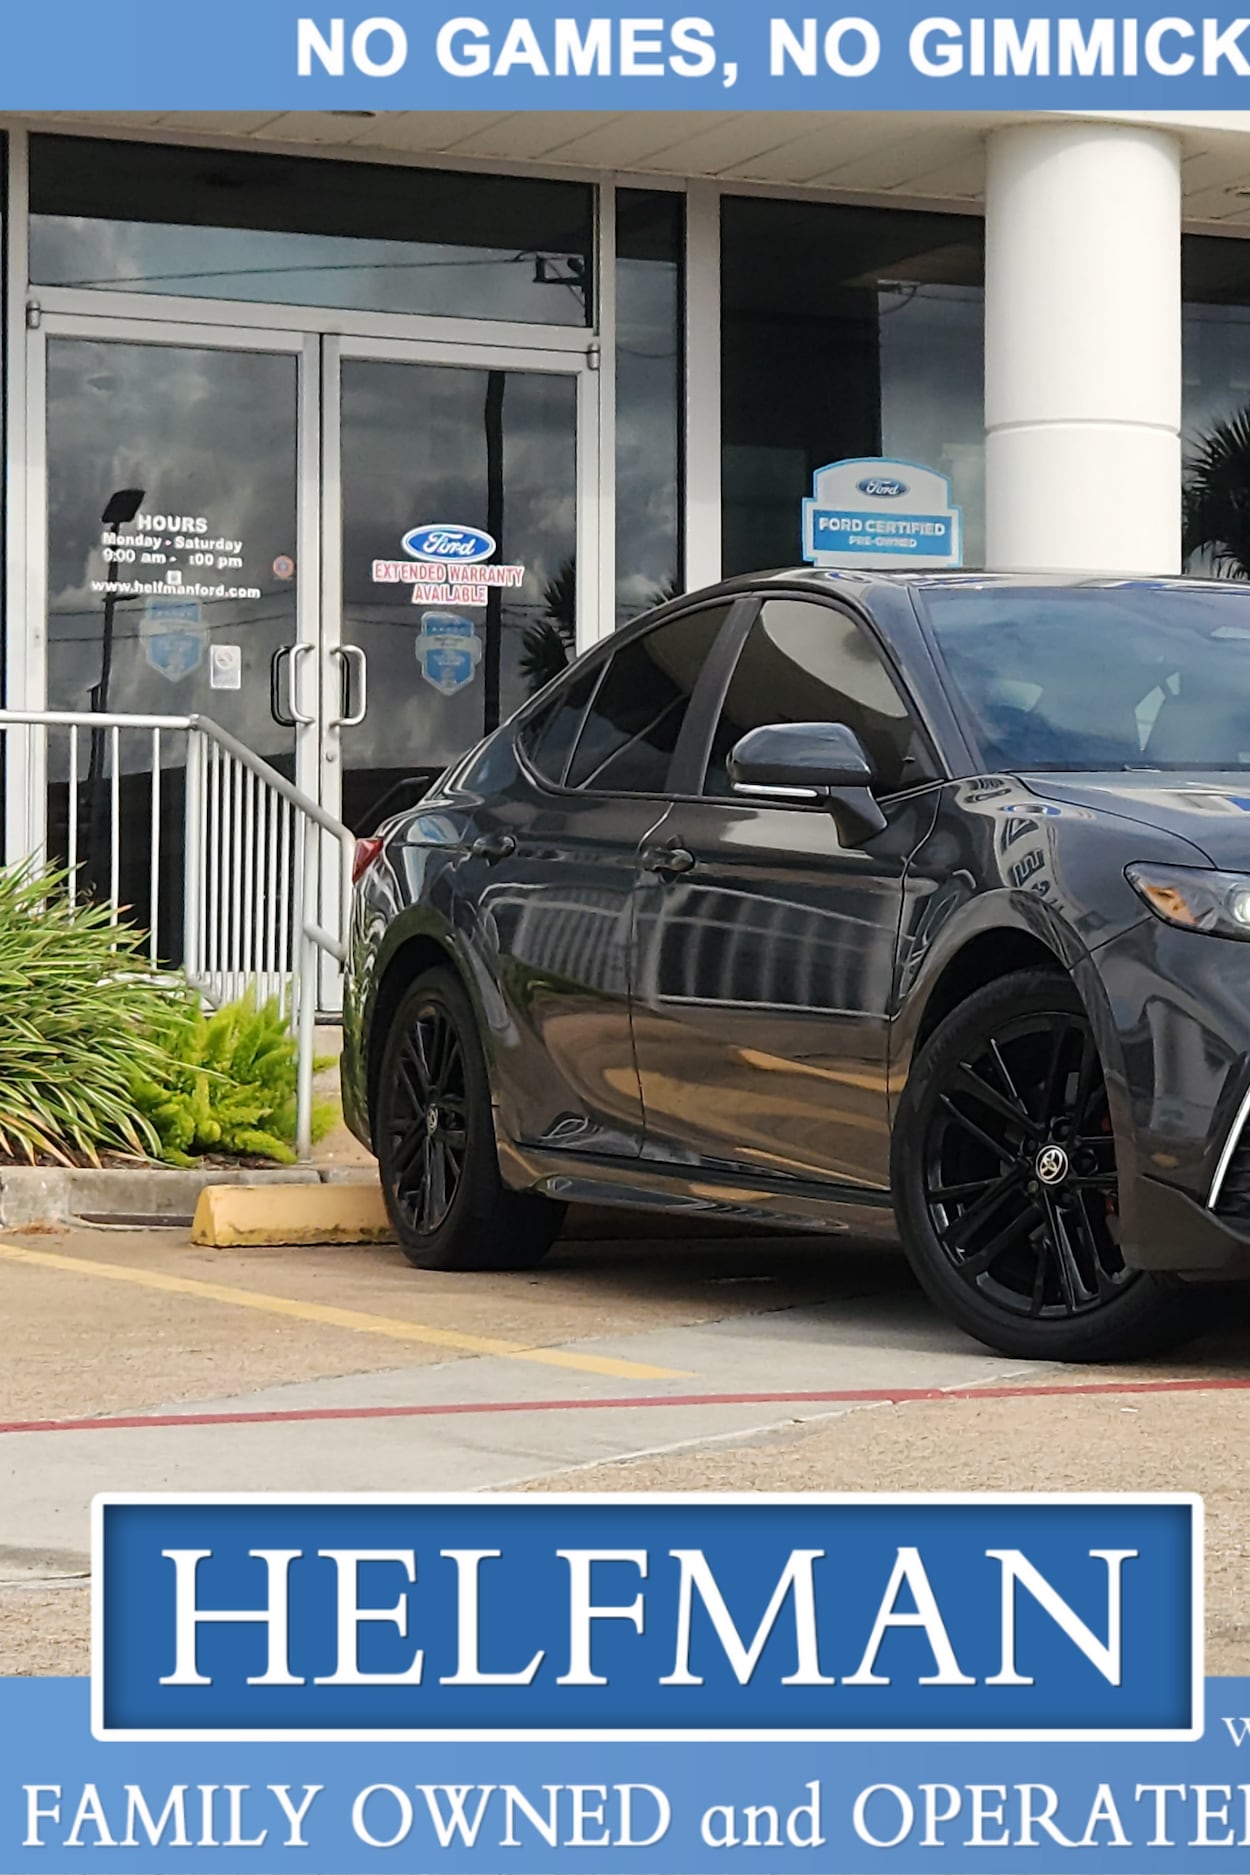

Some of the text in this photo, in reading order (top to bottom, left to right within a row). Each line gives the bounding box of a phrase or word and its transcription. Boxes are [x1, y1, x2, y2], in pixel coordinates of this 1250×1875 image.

[866, 480, 899, 495] Ford
[137, 513, 208, 533] HOURS
[819, 517, 945, 536] FORD CERTIFIED
[102, 532, 162, 549] Monday
[174, 535, 242, 553] Saturday
[423, 531, 476, 555] Ford
[848, 536, 917, 548] PRE-OWNED
[103, 548, 136, 563] 9:00
[140, 553, 167, 564] am
[217, 555, 243, 569] pm
[375, 562, 523, 584] EXTENDED WARRANTY
[91, 580, 261, 599] www.helfmanford.com
[415, 584, 486, 603] AVAILABLE
